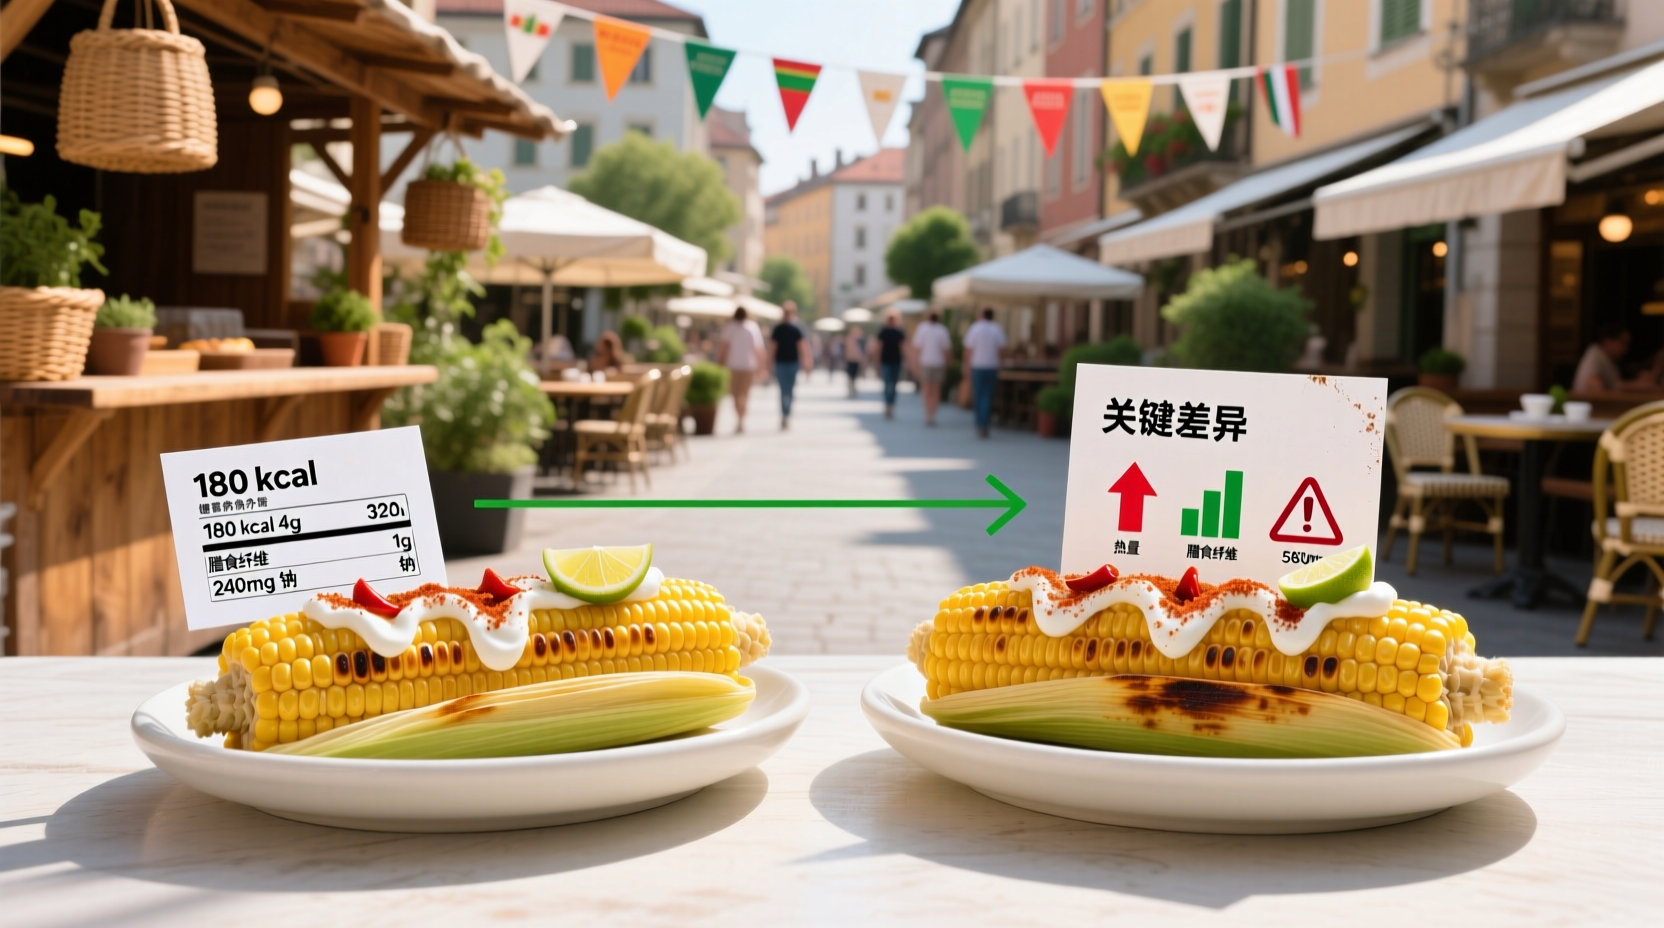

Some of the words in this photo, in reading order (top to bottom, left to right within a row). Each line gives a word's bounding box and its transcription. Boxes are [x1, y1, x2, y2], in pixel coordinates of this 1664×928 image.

[1102, 397, 1247, 443] 关键差异
[193, 470, 249, 498] 180
[254, 459, 318, 492] kcal
[203, 520, 237, 540] 180
[240, 515, 275, 536] kcal
[278, 514, 302, 535] 4g
[392, 533, 412, 553] 1g
[213, 577, 276, 597] 240mg
